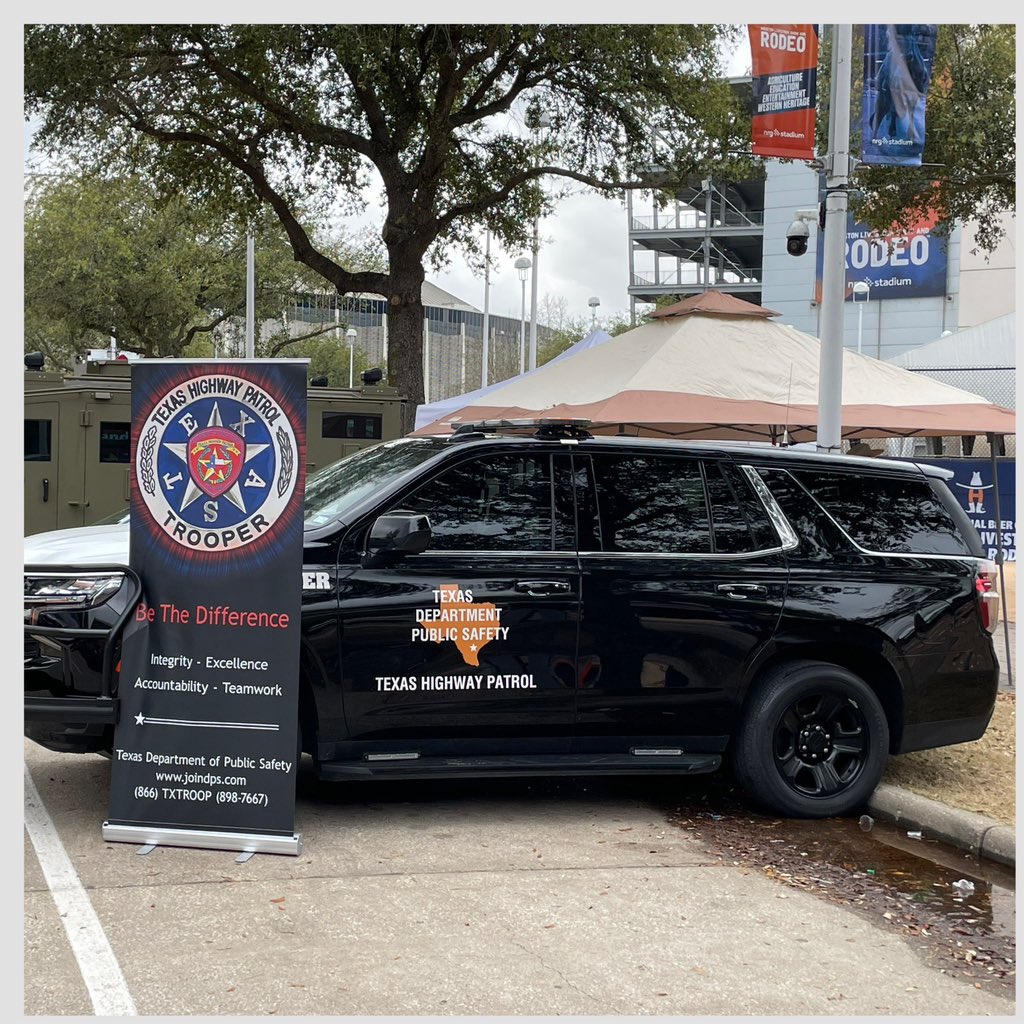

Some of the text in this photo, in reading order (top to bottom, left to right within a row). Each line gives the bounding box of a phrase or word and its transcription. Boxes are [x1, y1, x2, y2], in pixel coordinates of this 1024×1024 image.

[760, 31, 806, 53] RODEO
[767, 73, 803, 85] AGRICULTURE
[769, 82, 800, 93] EDUCATION
[762, 89, 807, 103] ENTERTAINMENT
[758, 97, 810, 112] WESTERN HERITAGE
[780, 130, 805, 139] stadium
[874, 277, 912, 287] stadium
[151, 377, 281, 427] TEXAS HIGHWAY PATROL
[164, 511, 270, 548] TROOPER
[432, 589, 474, 604] TEXAS
[135, 602, 290, 629] Be The Difference
[415, 608, 502, 623] DEPARTMENT
[411, 627, 510, 642] PUBLIC SAFETY
[151, 654, 193, 669] Integrity
[206, 656, 269, 671] Excellence
[134, 677, 209, 695] Accountability
[222, 682, 283, 696] Teamwork
[375, 674, 537, 692] TEXAS HIGHWAY PATROL
[116, 750, 292, 773] Texas Department of Public Safety
[155, 772, 247, 787] www.joindps.com
[134, 786, 269, 807] (866) TXTROOP (898-7667)
